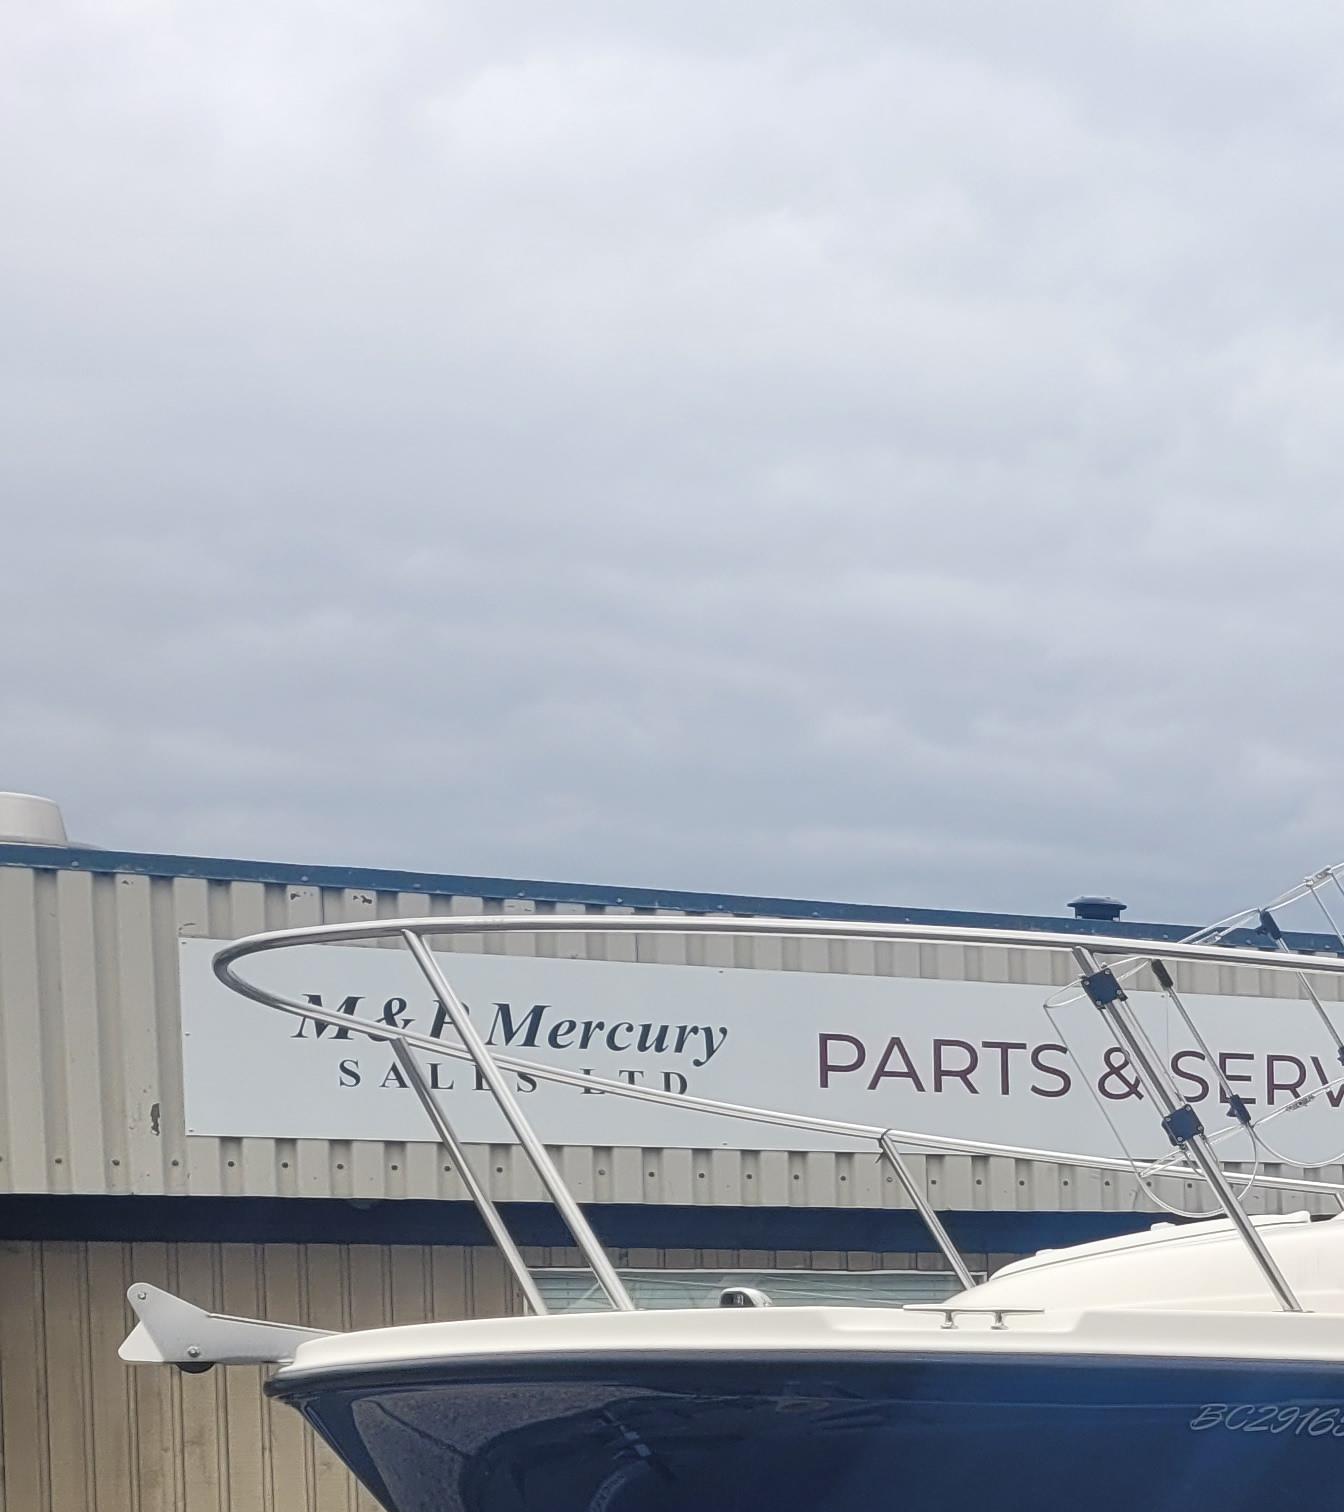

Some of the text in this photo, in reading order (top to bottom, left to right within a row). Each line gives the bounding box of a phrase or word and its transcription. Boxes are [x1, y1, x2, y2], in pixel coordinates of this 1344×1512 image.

[291, 993, 366, 1040] M
[367, 997, 416, 1042] &
[485, 1002, 728, 1067] Mercury
[818, 1032, 1072, 1098] PARTS
[1097, 1046, 1145, 1101] &
